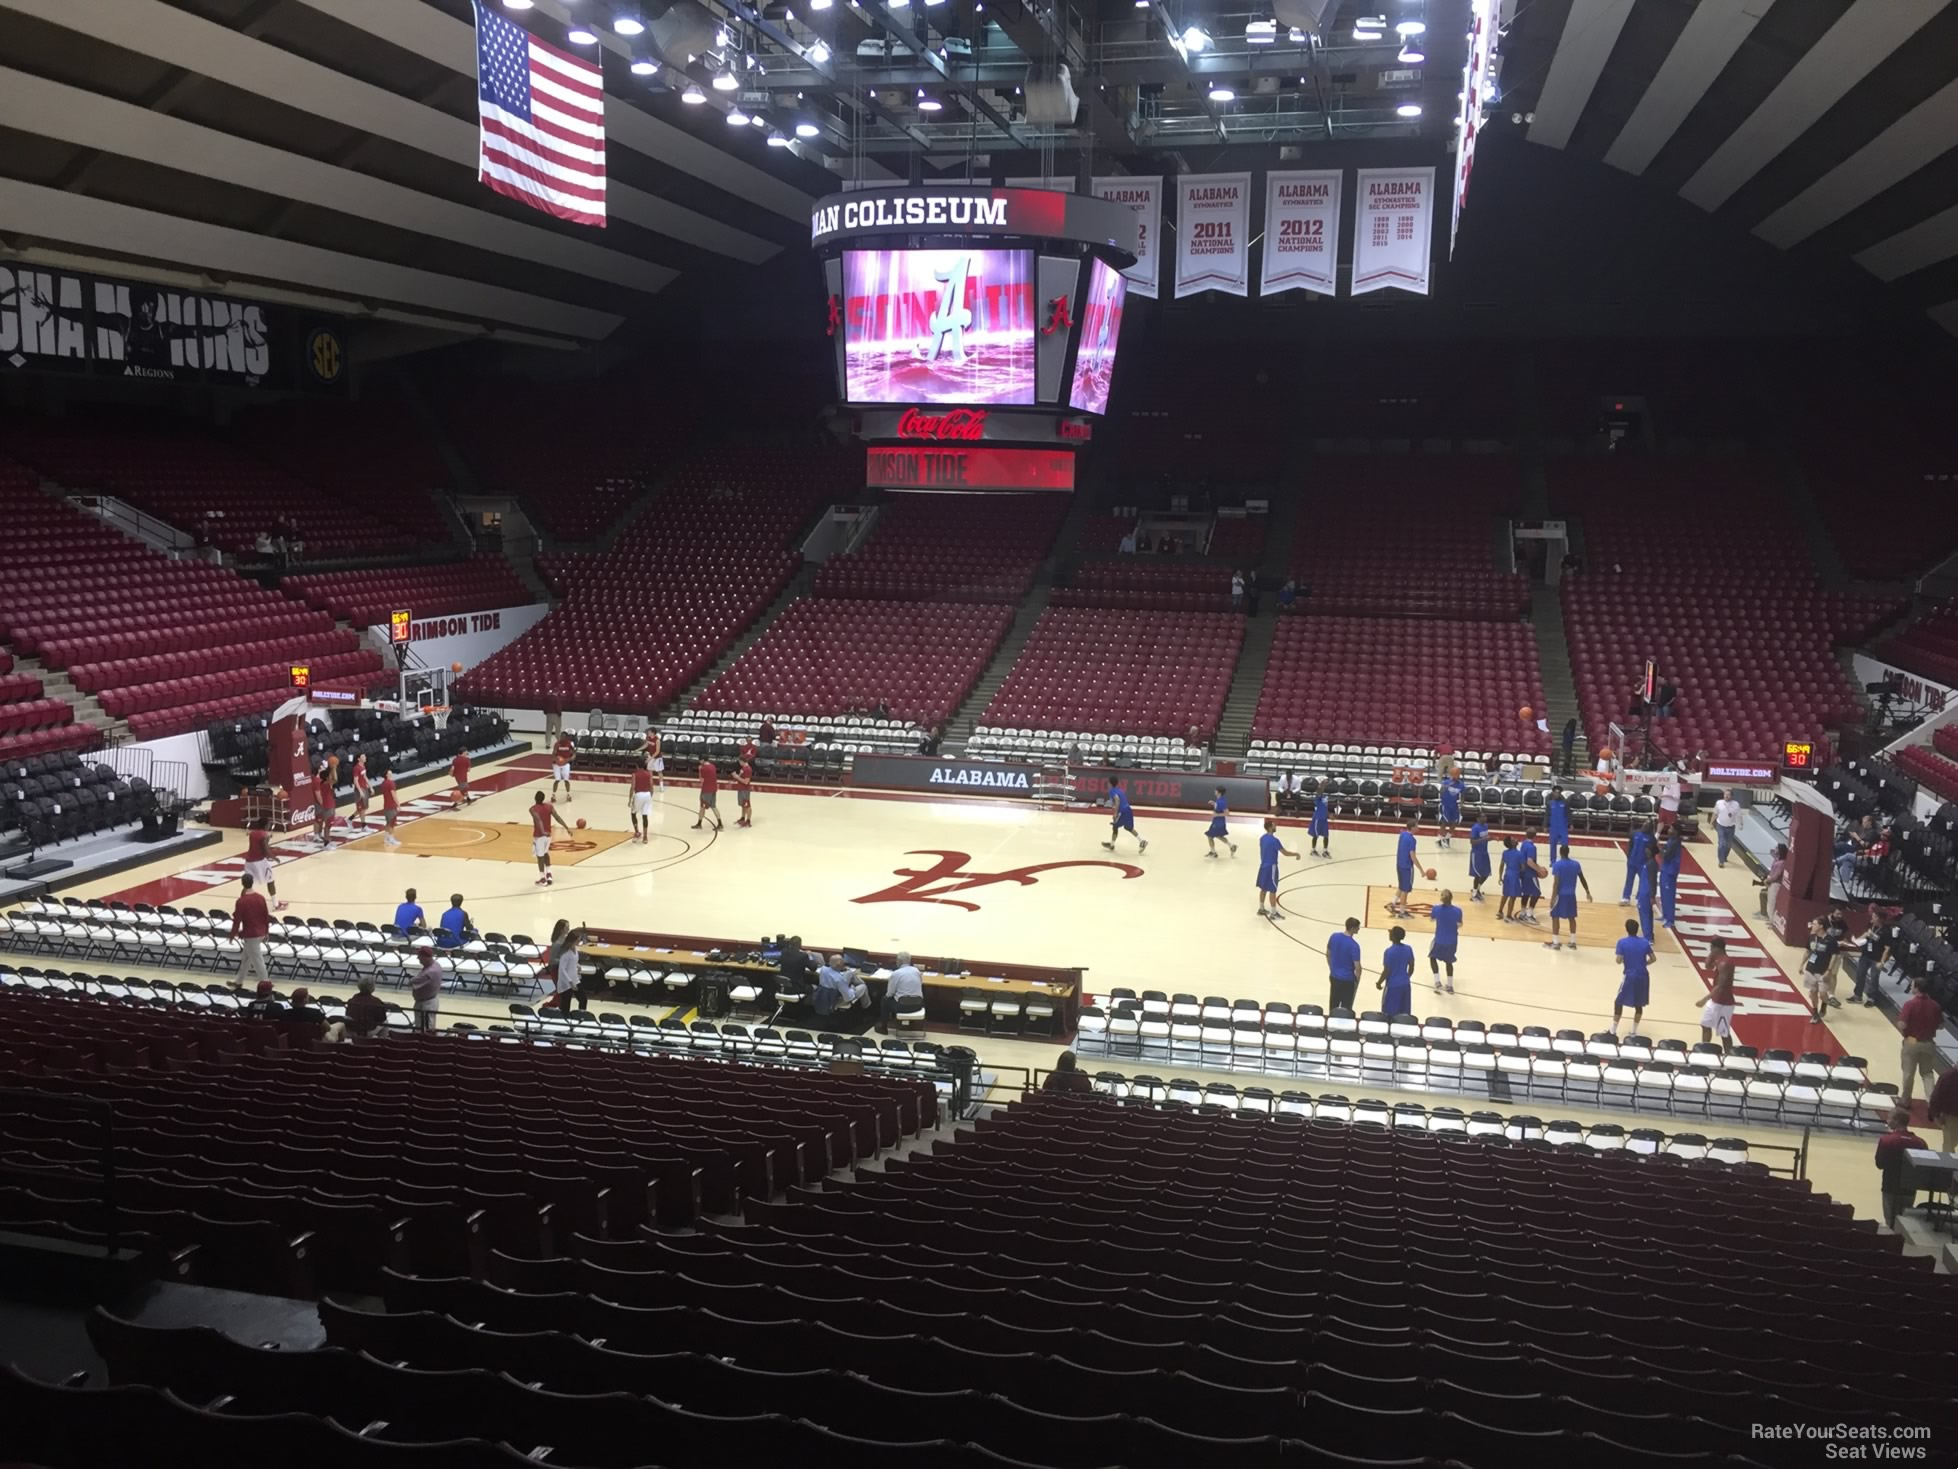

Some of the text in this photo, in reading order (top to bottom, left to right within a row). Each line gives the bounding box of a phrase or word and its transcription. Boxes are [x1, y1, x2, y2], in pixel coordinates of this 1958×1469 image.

[1189, 187, 1238, 200] ALABAMA
[1278, 184, 1328, 197] ALABAMA
[1369, 182, 1421, 195] ALABAMA
[845, 197, 1007, 229] COLISEUM
[1194, 222, 1231, 238] 2011
[1280, 219, 1323, 235] 2012
[1191, 239, 1234, 247] NATIONAL
[1278, 237, 1323, 245] NATIONAL
[1190, 247, 1234, 255] CHAMPIONS
[924, 454, 968, 483] TIDE
[394, 623, 408, 640] 30
[412, 612, 500, 641] RIMSON TIDE
[295, 676, 306, 685] 30
[1791, 754, 1806, 765] 30
[1709, 767, 1772, 778] ROLLTIDE.COM
[929, 768, 1029, 789] ALABAMA
[1134, 780, 1182, 797] TIDE
